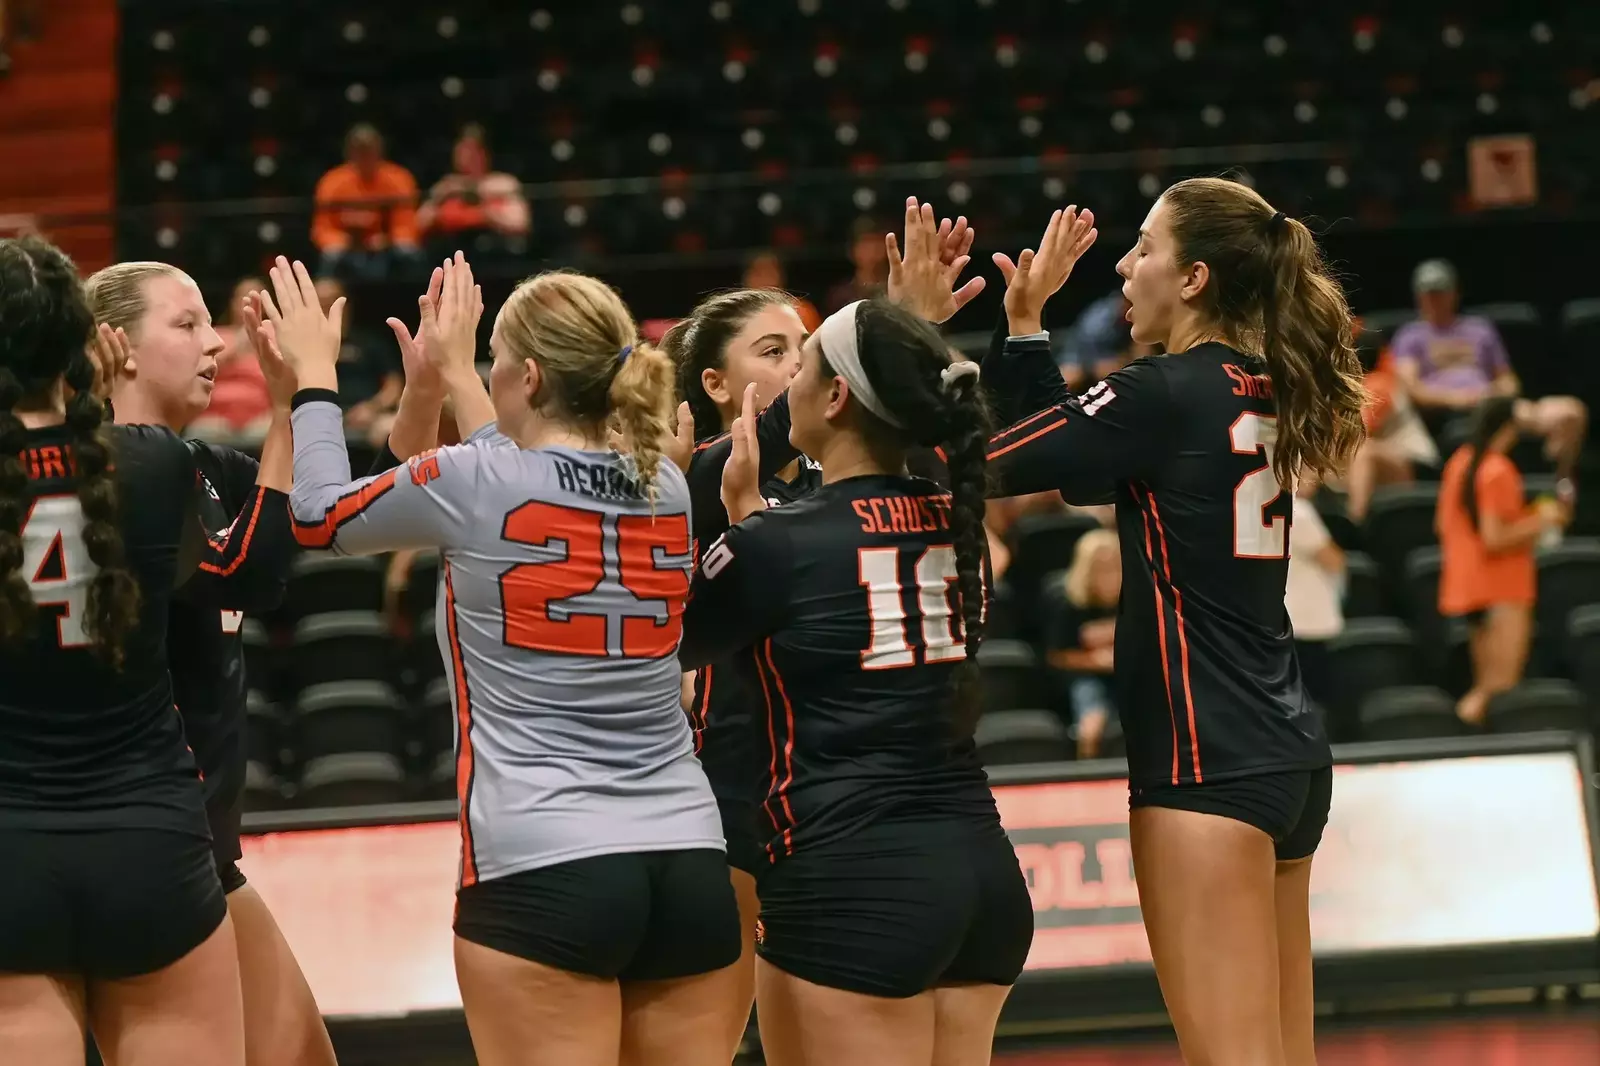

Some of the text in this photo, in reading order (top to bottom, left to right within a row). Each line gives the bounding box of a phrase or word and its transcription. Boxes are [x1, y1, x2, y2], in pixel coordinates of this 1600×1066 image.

[851, 494, 953, 533] SCHUST
[1228, 410, 1291, 559] 2
[19, 493, 99, 649] 4
[498, 499, 690, 659] 25
